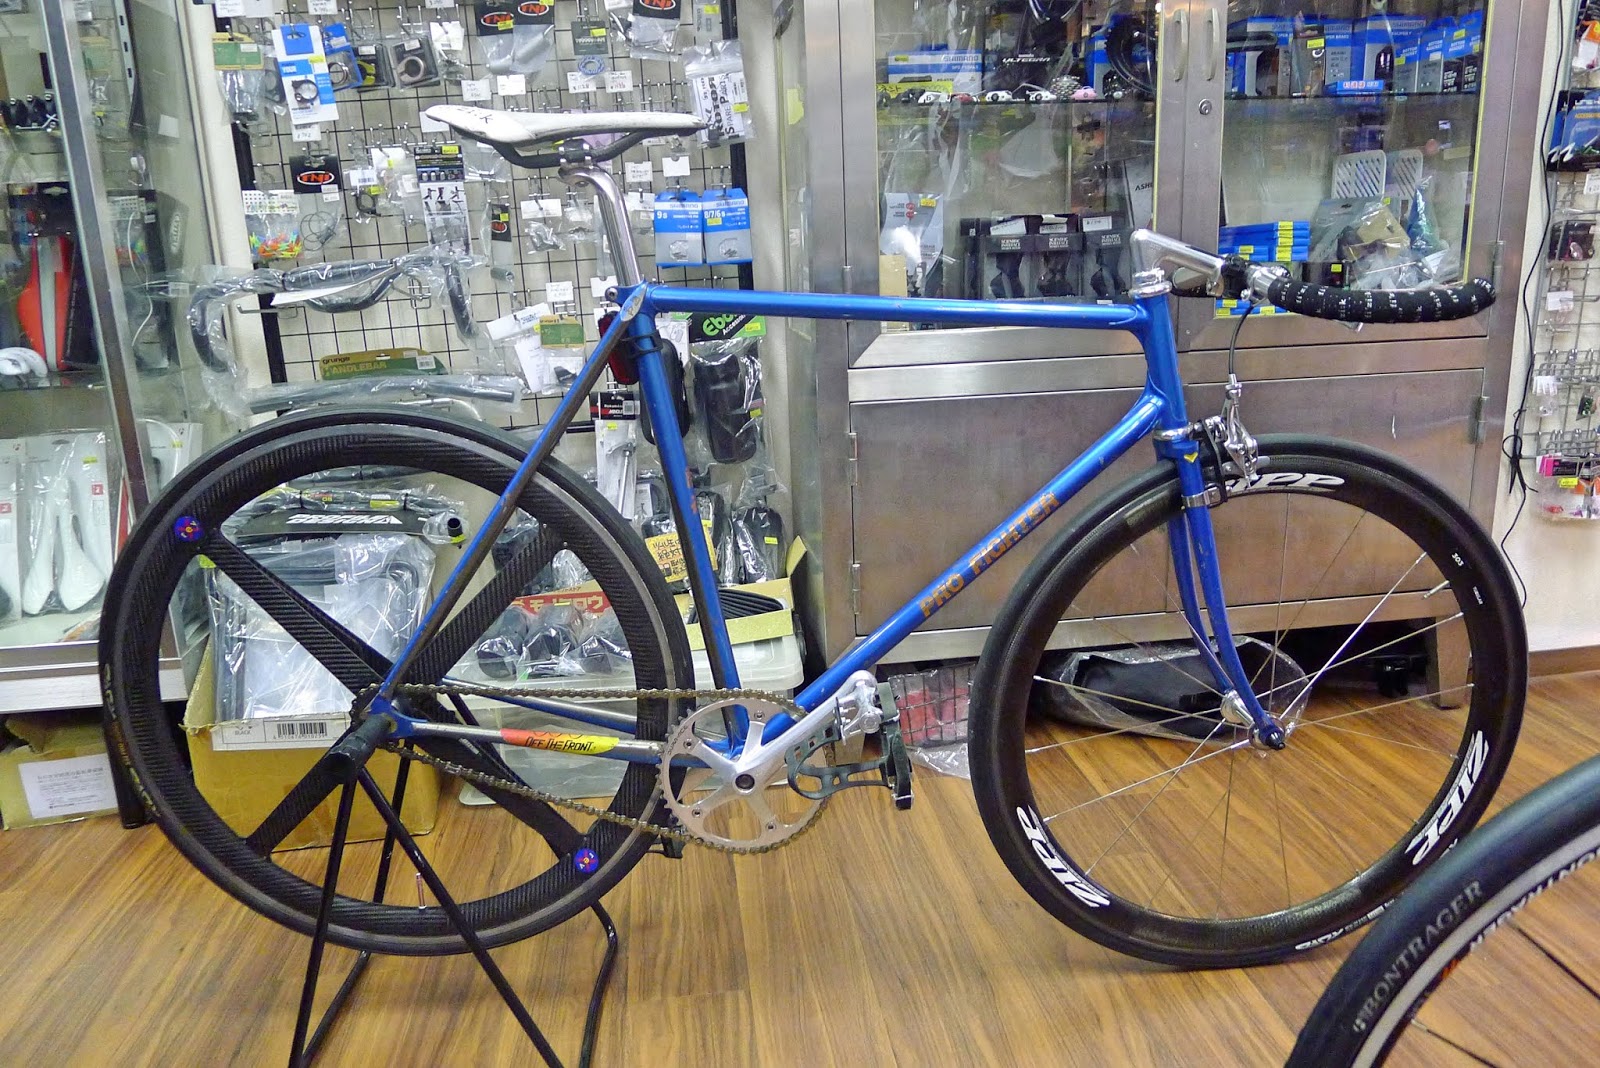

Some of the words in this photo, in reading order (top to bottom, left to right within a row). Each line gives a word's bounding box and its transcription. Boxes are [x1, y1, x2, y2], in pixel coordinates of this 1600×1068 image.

[718, 73, 729, 104] PARTS
[725, 106, 735, 134] SPARE
[322, 356, 350, 365] grunge
[919, 572, 965, 618] PRO
[969, 491, 1060, 575] FIGHTER
[1451, 553, 1464, 566] 303
[524, 736, 546, 748] OFF
[546, 738, 564, 751] THE
[563, 740, 595, 752] FRONT
[1358, 879, 1484, 1020] BONTRAGER
